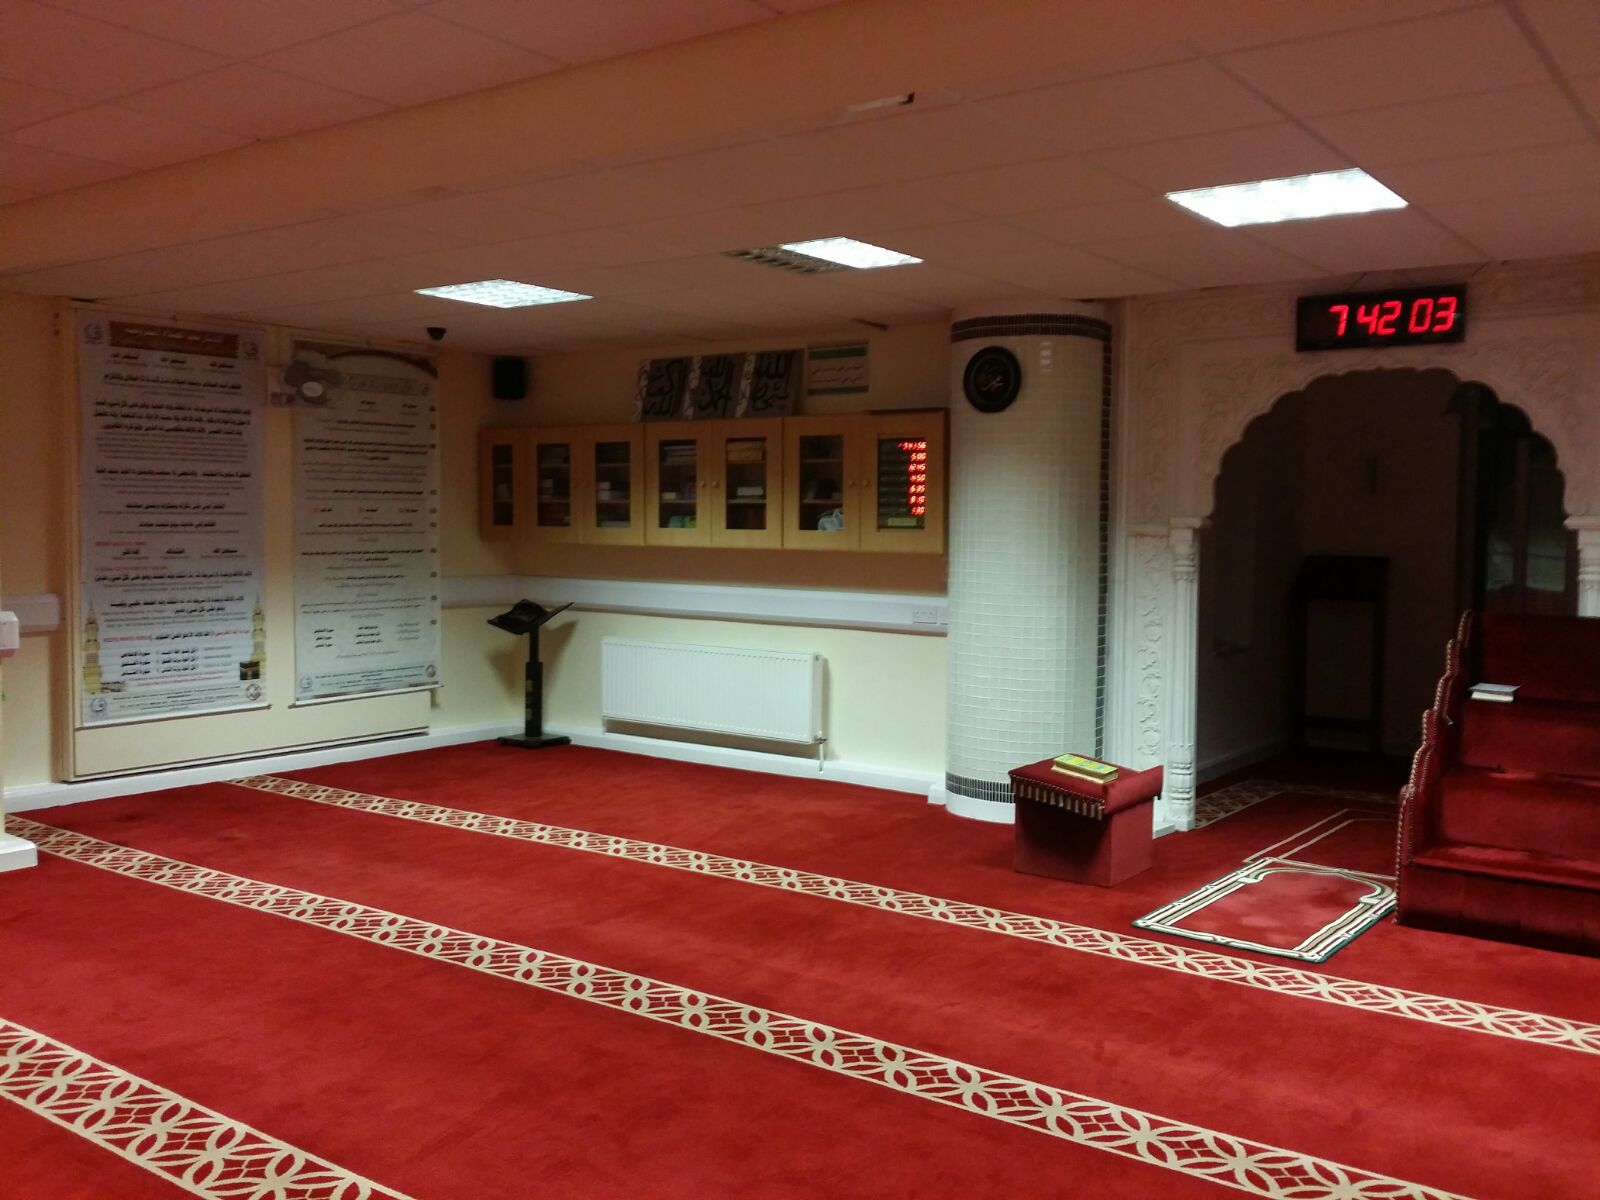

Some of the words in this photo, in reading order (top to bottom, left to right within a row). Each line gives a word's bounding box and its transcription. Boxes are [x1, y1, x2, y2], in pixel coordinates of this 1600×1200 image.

[1329, 305, 1349, 337] 7
[1357, 301, 1402, 336] 42
[1408, 297, 1458, 333] 03
